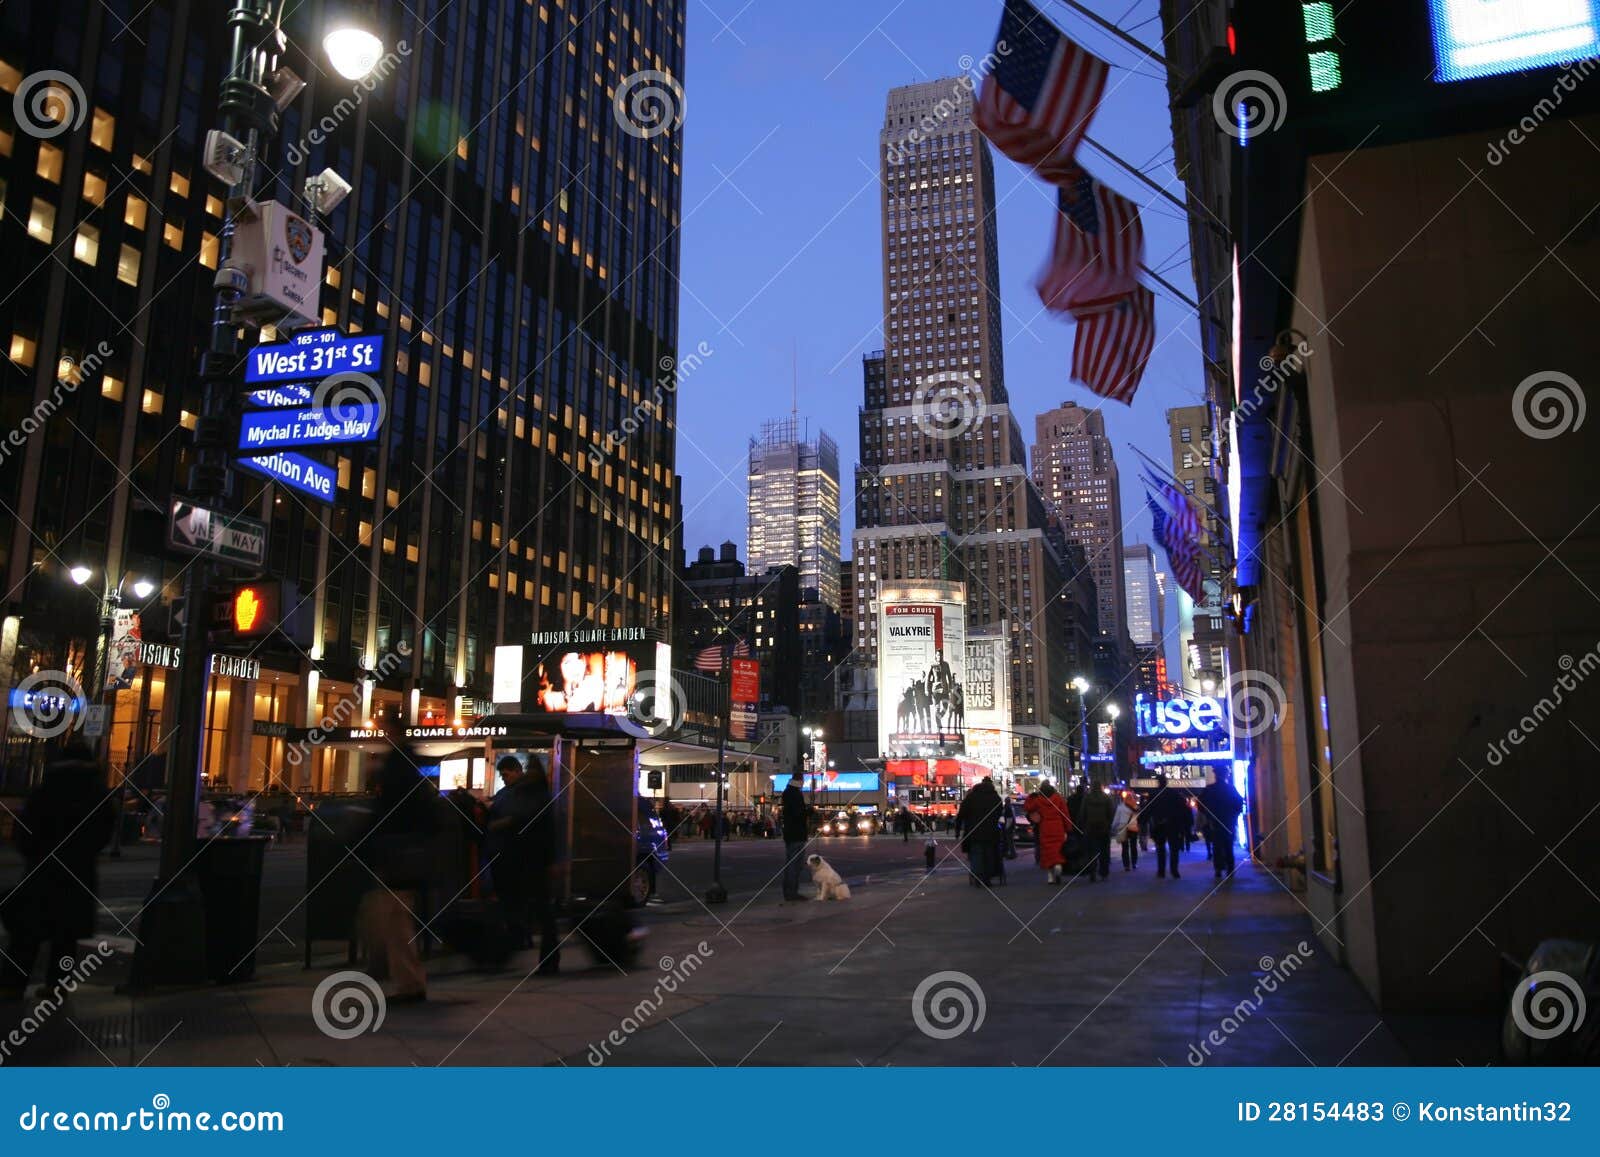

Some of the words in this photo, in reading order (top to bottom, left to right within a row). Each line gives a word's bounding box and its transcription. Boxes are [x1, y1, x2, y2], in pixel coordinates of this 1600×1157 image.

[297, 335, 312, 345] 165
[320, 333, 335, 343] 101
[257, 351, 307, 375] West
[310, 345, 347, 371] 31st
[351, 343, 373, 367] St
[252, 389, 303, 406] even
[298, 412, 323, 421] Father
[247, 424, 289, 445] Mychal
[293, 424, 301, 439] F.
[303, 421, 341, 440] Judge
[343, 420, 371, 437] Way
[252, 452, 300, 481] shion
[303, 466, 331, 494] Ave
[231, 531, 257, 551] WAY
[531, 630, 570, 645] MADISON
[574, 629, 606, 642] SQUARE
[611, 627, 646, 641] GARDEN
[889, 626, 931, 636] VALKYRIE
[139, 642, 169, 667] ISON
[968, 645, 991, 657] THE
[219, 656, 260, 680] GARDEN
[968, 683, 992, 694] THE
[1135, 693, 1223, 737] fuse
[350, 729, 388, 738] MADIS
[405, 727, 453, 737] SQUARE
[457, 725, 507, 736] GARDEN
